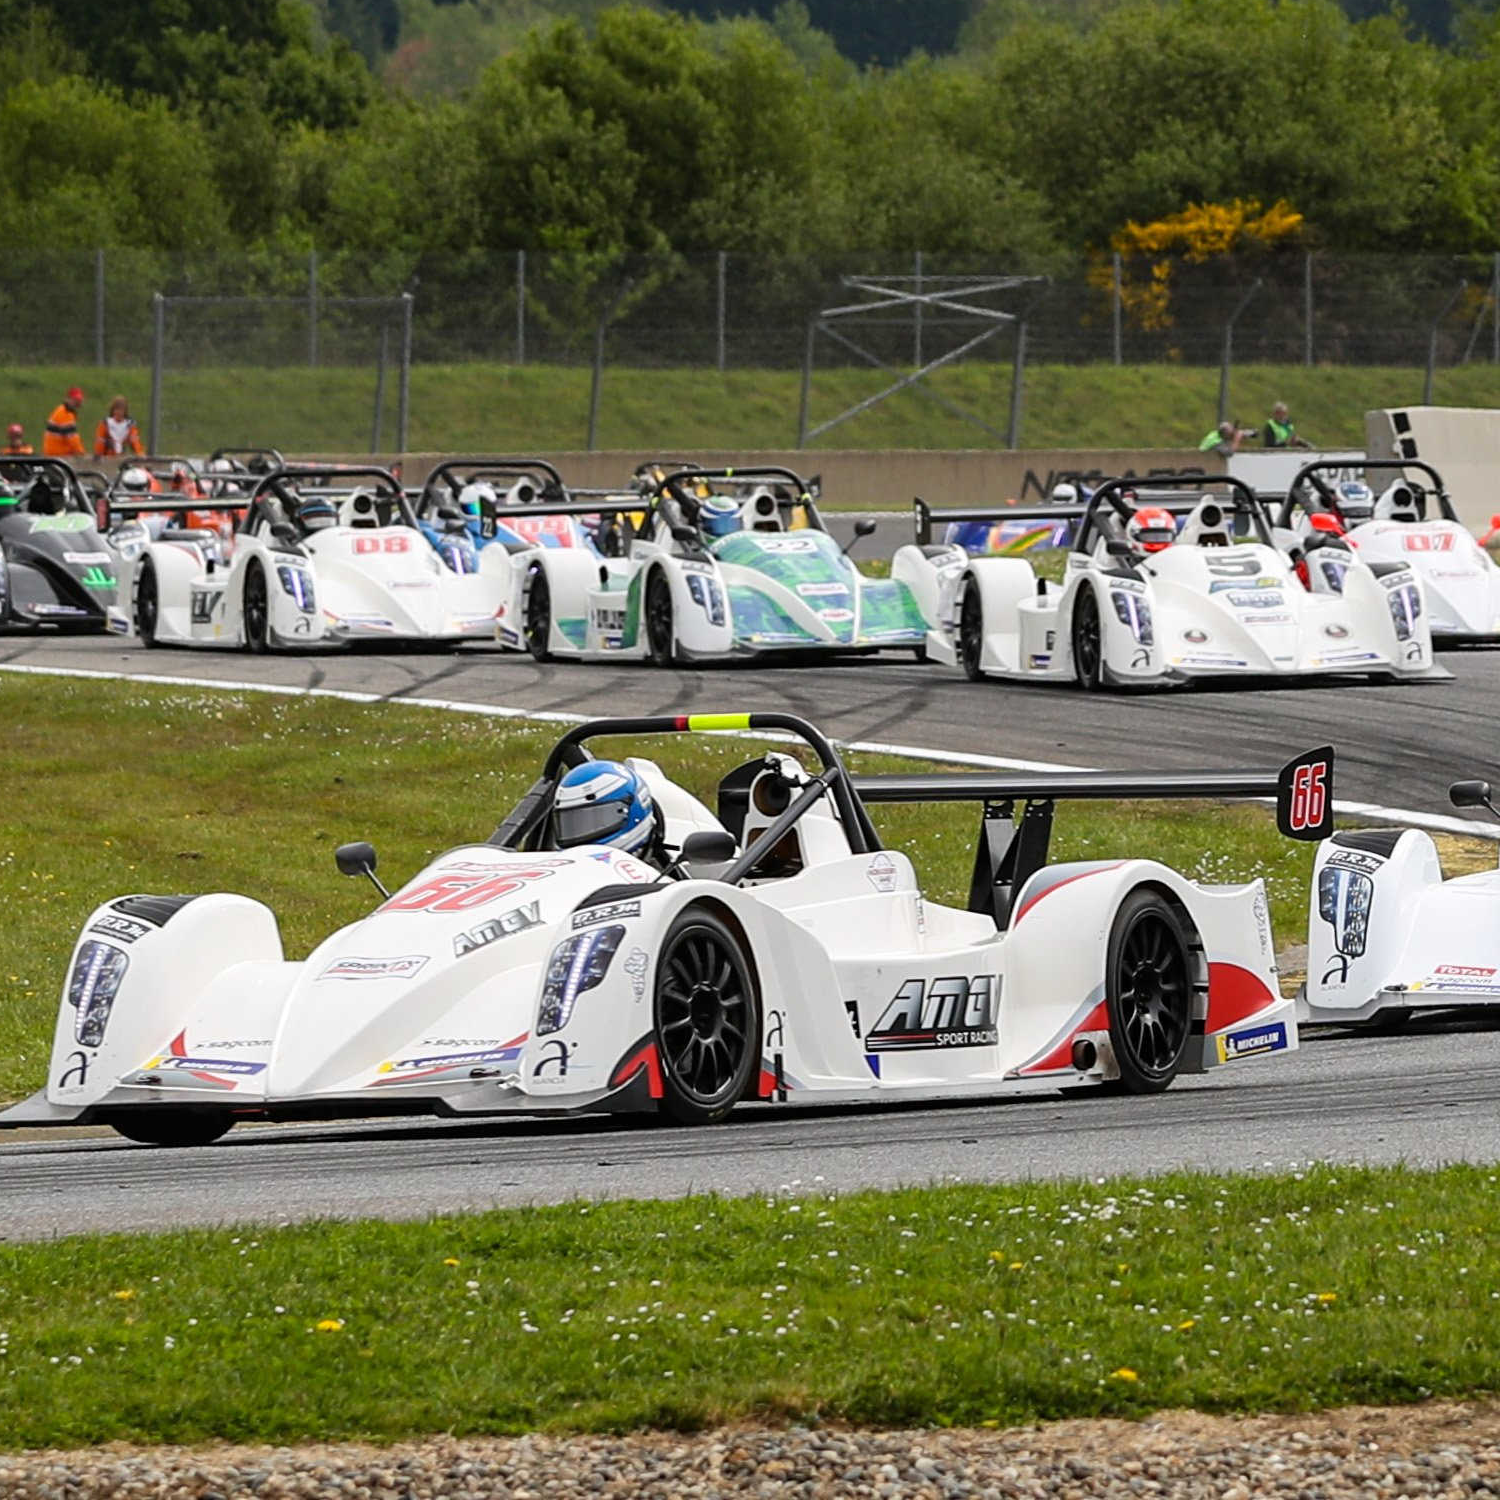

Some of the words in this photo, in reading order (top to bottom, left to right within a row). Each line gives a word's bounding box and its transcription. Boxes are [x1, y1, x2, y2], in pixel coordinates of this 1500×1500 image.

[1204, 552, 1264, 577] 5
[1290, 762, 1326, 831] 66
[378, 869, 556, 914] 66
[1438, 966, 1495, 977] TOTAL
[936, 1032, 969, 1046] SPORT
[970, 1030, 998, 1044] RACING
[1237, 1030, 1280, 1051] MICHELIN
[418, 1052, 505, 1067] MICHELIN
